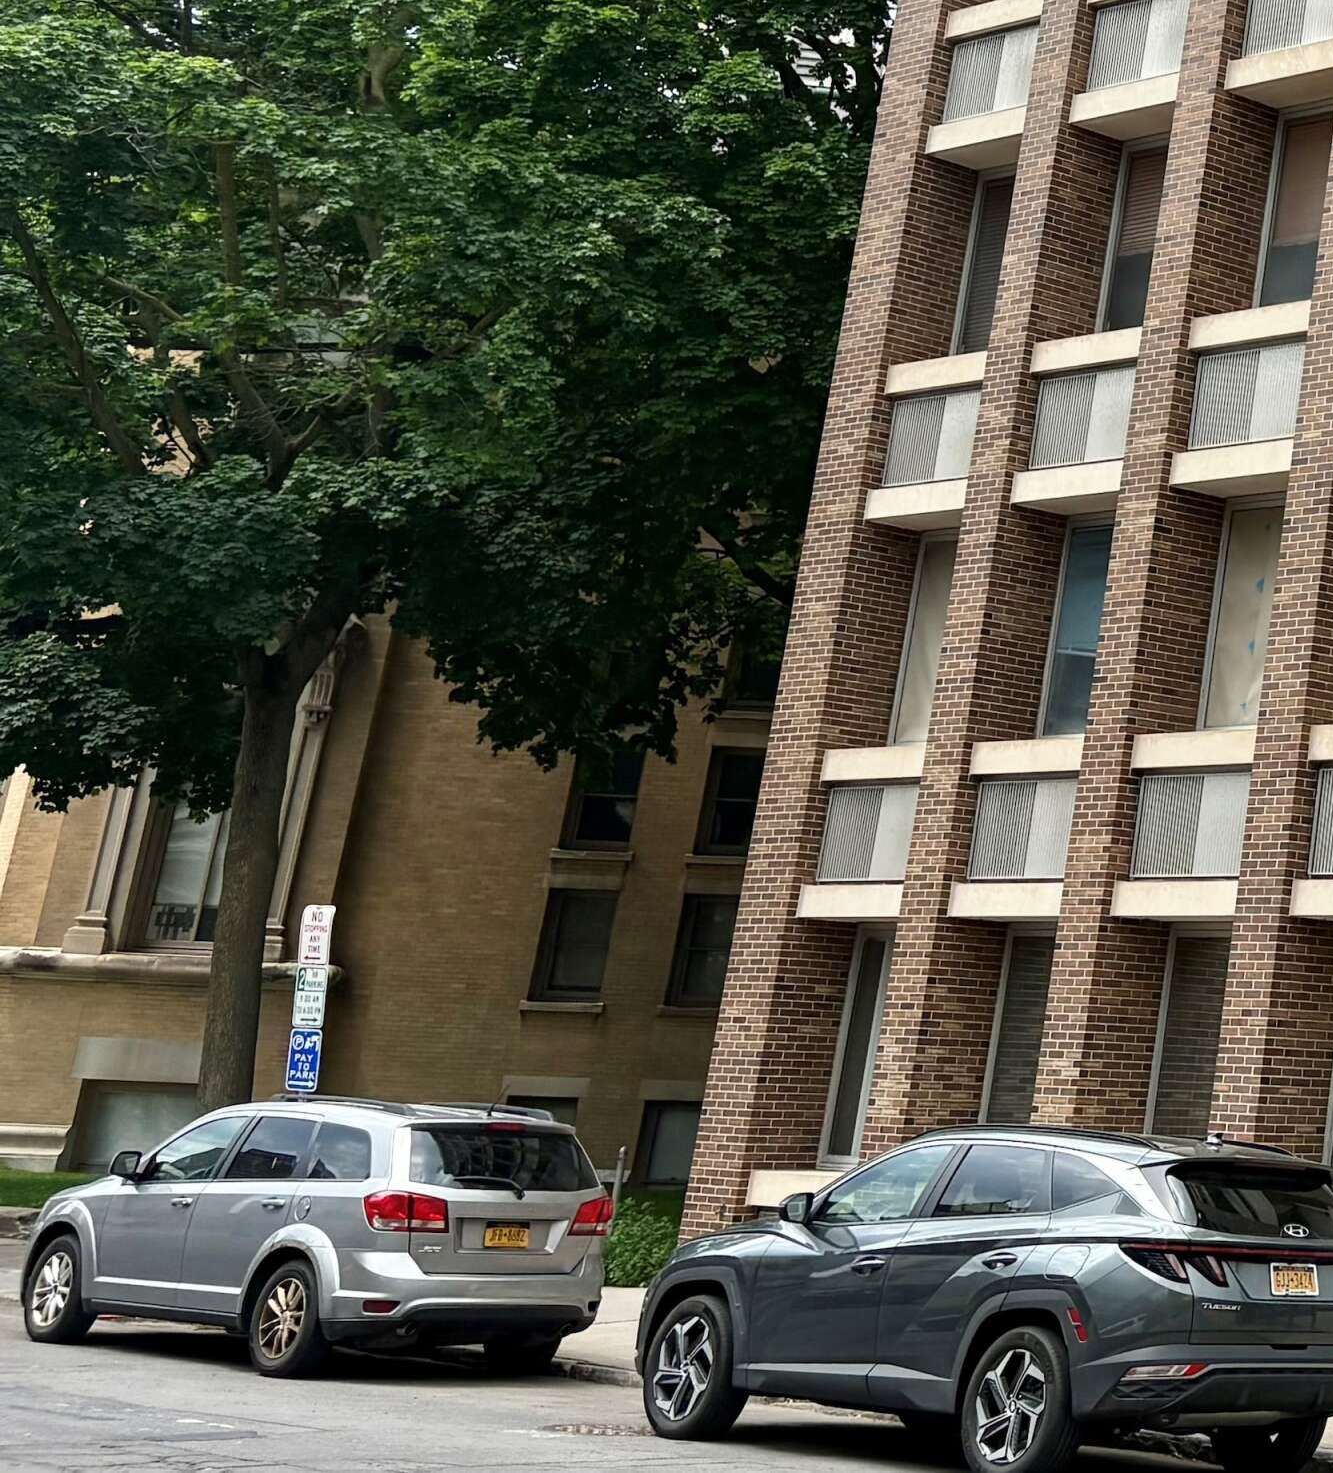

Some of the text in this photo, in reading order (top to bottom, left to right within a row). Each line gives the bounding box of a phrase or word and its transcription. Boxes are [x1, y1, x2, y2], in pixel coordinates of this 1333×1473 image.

[311, 911, 324, 923] NO
[298, 969, 306, 989] 2
[294, 1053, 314, 1062] PAY
[297, 1062, 310, 1071] TO
[289, 1070, 316, 1080] PARK
